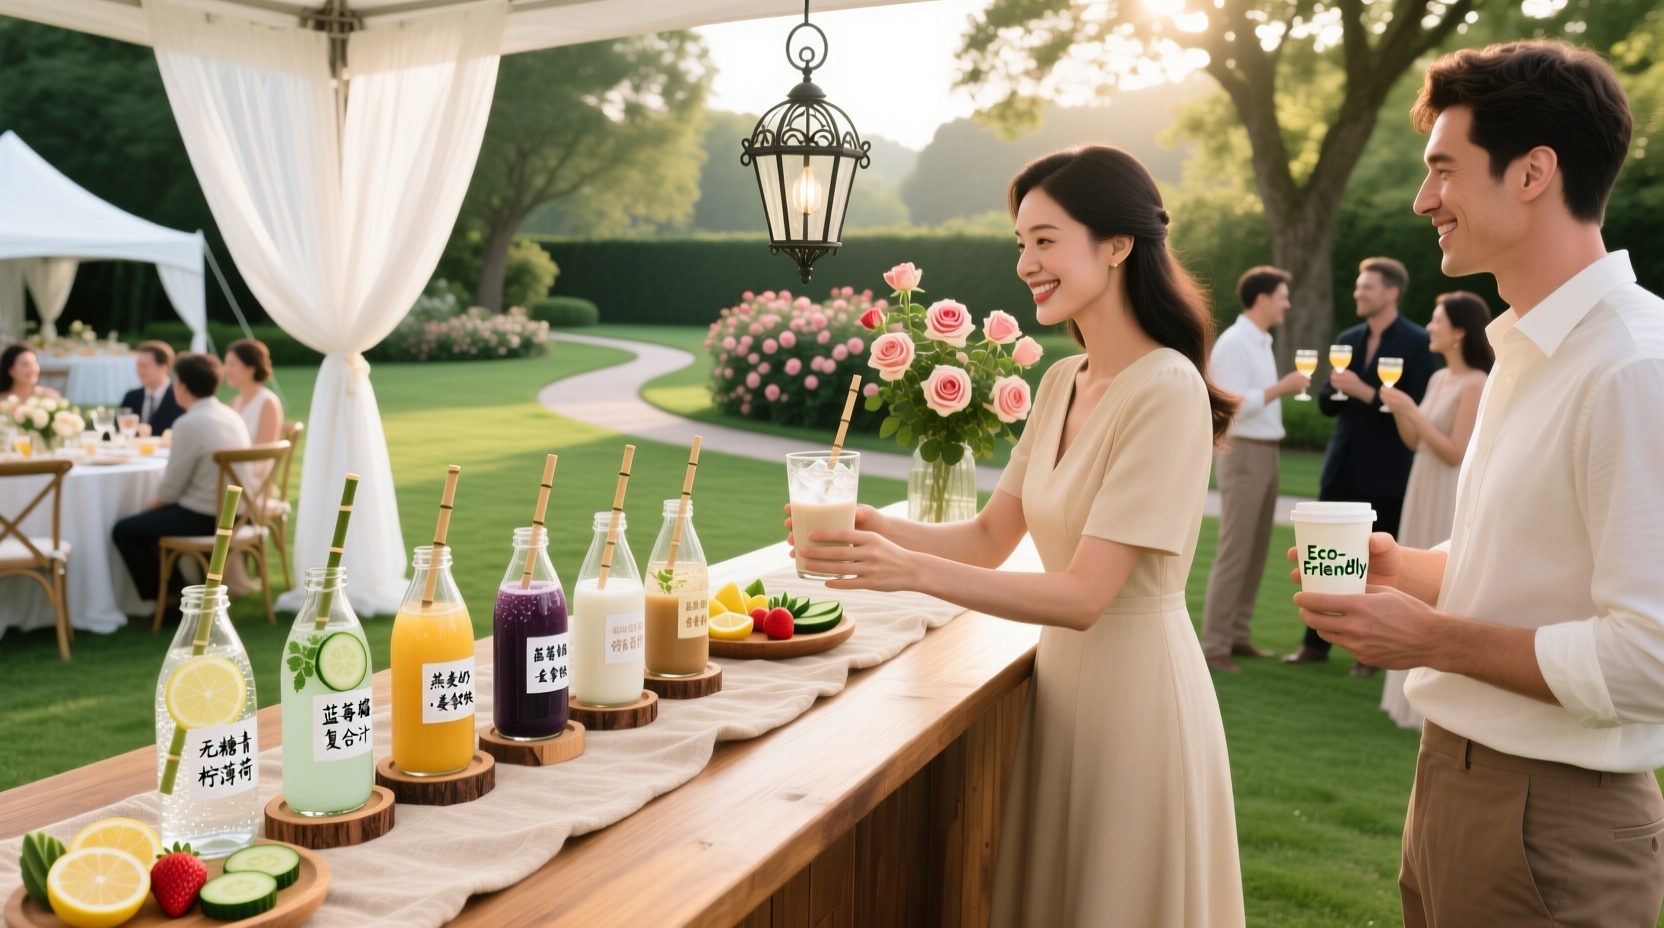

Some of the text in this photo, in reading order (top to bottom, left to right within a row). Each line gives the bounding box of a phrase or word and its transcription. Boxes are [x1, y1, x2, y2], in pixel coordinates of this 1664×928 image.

[1307, 544, 1347, 561] Eco-
[199, 729, 252, 758] 无糖青
[323, 723, 371, 751] 复合汁
[198, 756, 253, 788] 柠薄荷
